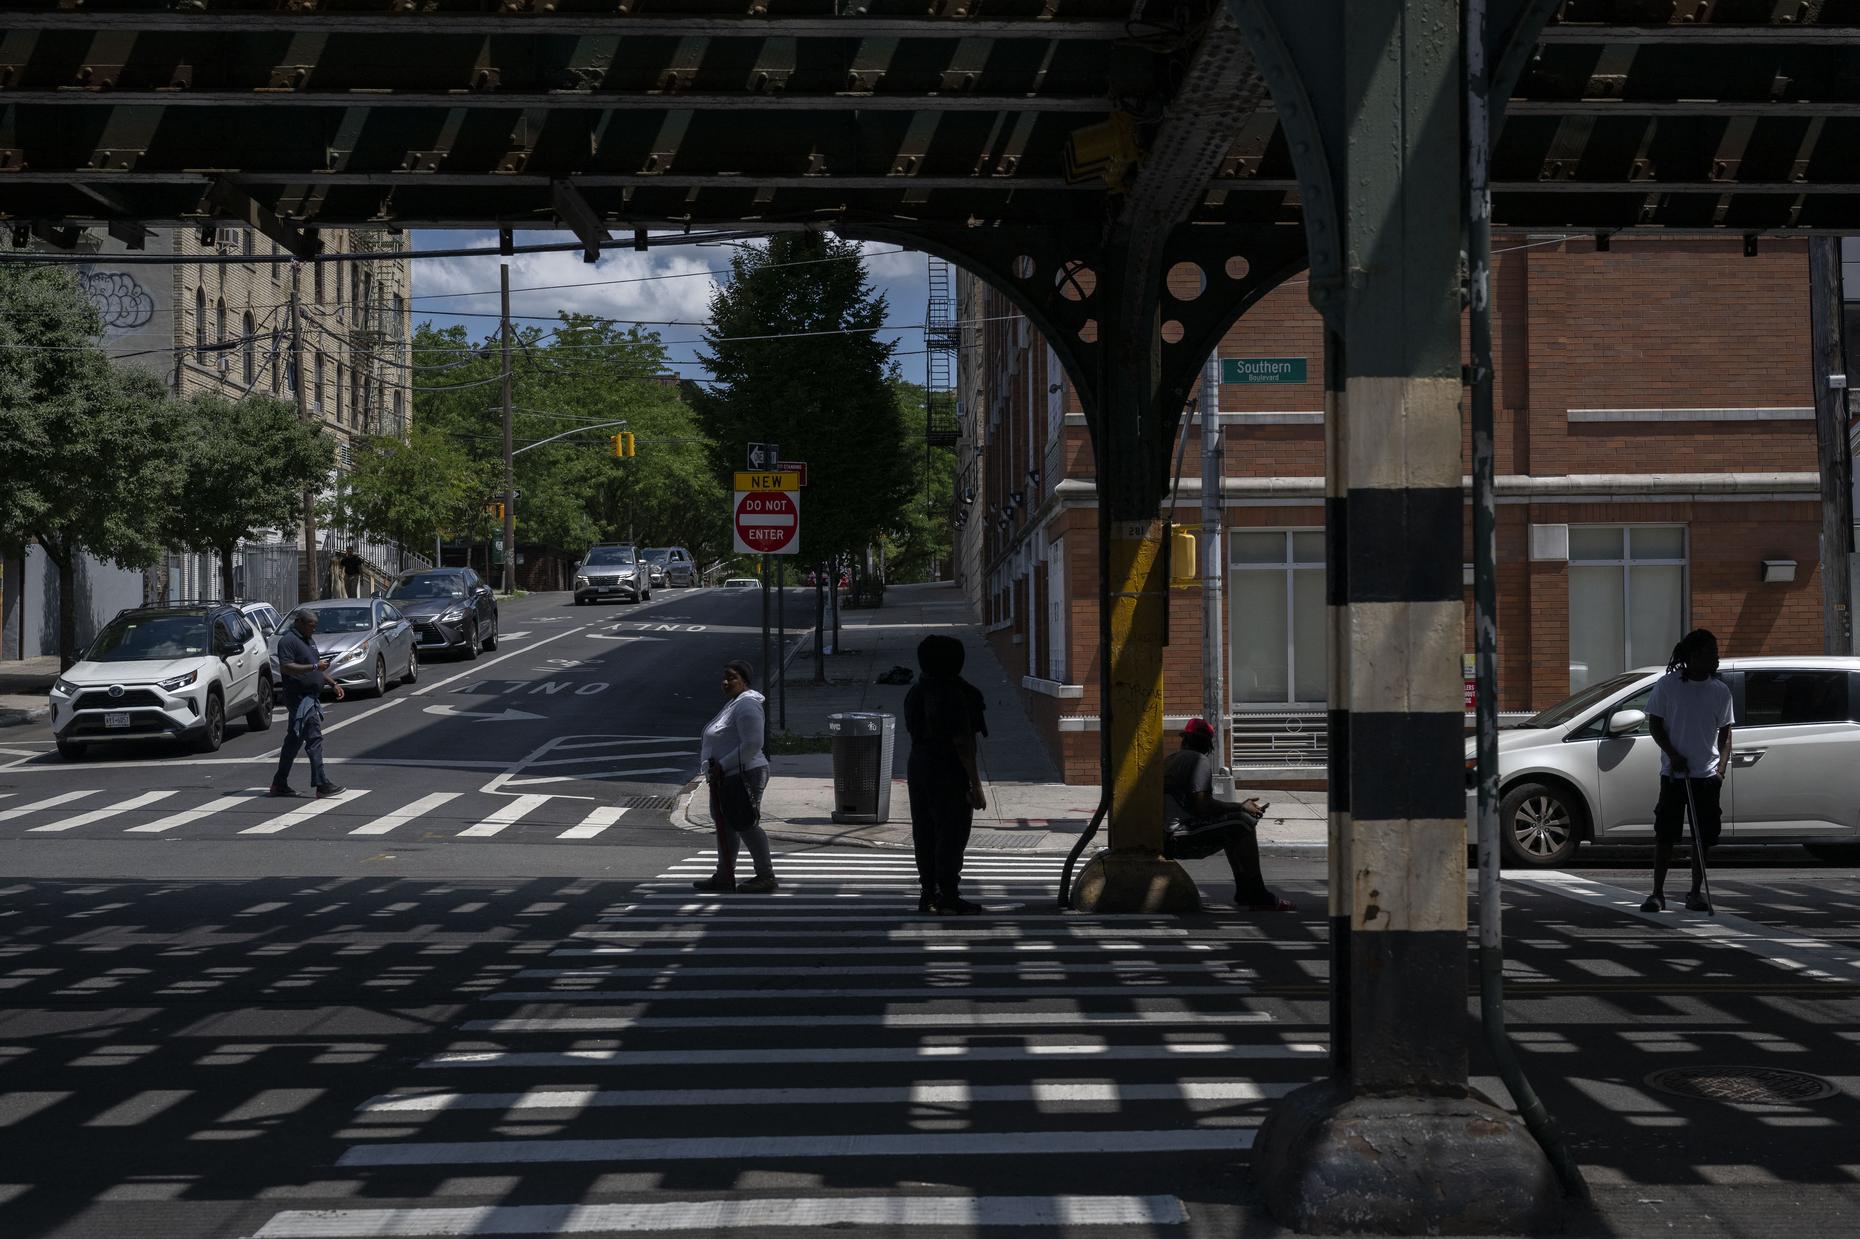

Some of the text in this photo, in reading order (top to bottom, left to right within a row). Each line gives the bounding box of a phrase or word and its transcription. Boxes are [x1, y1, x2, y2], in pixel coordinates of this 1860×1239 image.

[1237, 360, 1291, 373] Southern
[751, 475, 782, 488] NEW
[746, 500, 787, 511] DO NOT
[748, 529, 784, 540] ENTER
[601, 623, 708, 632] ONLY
[448, 681, 611, 695] ONLY
